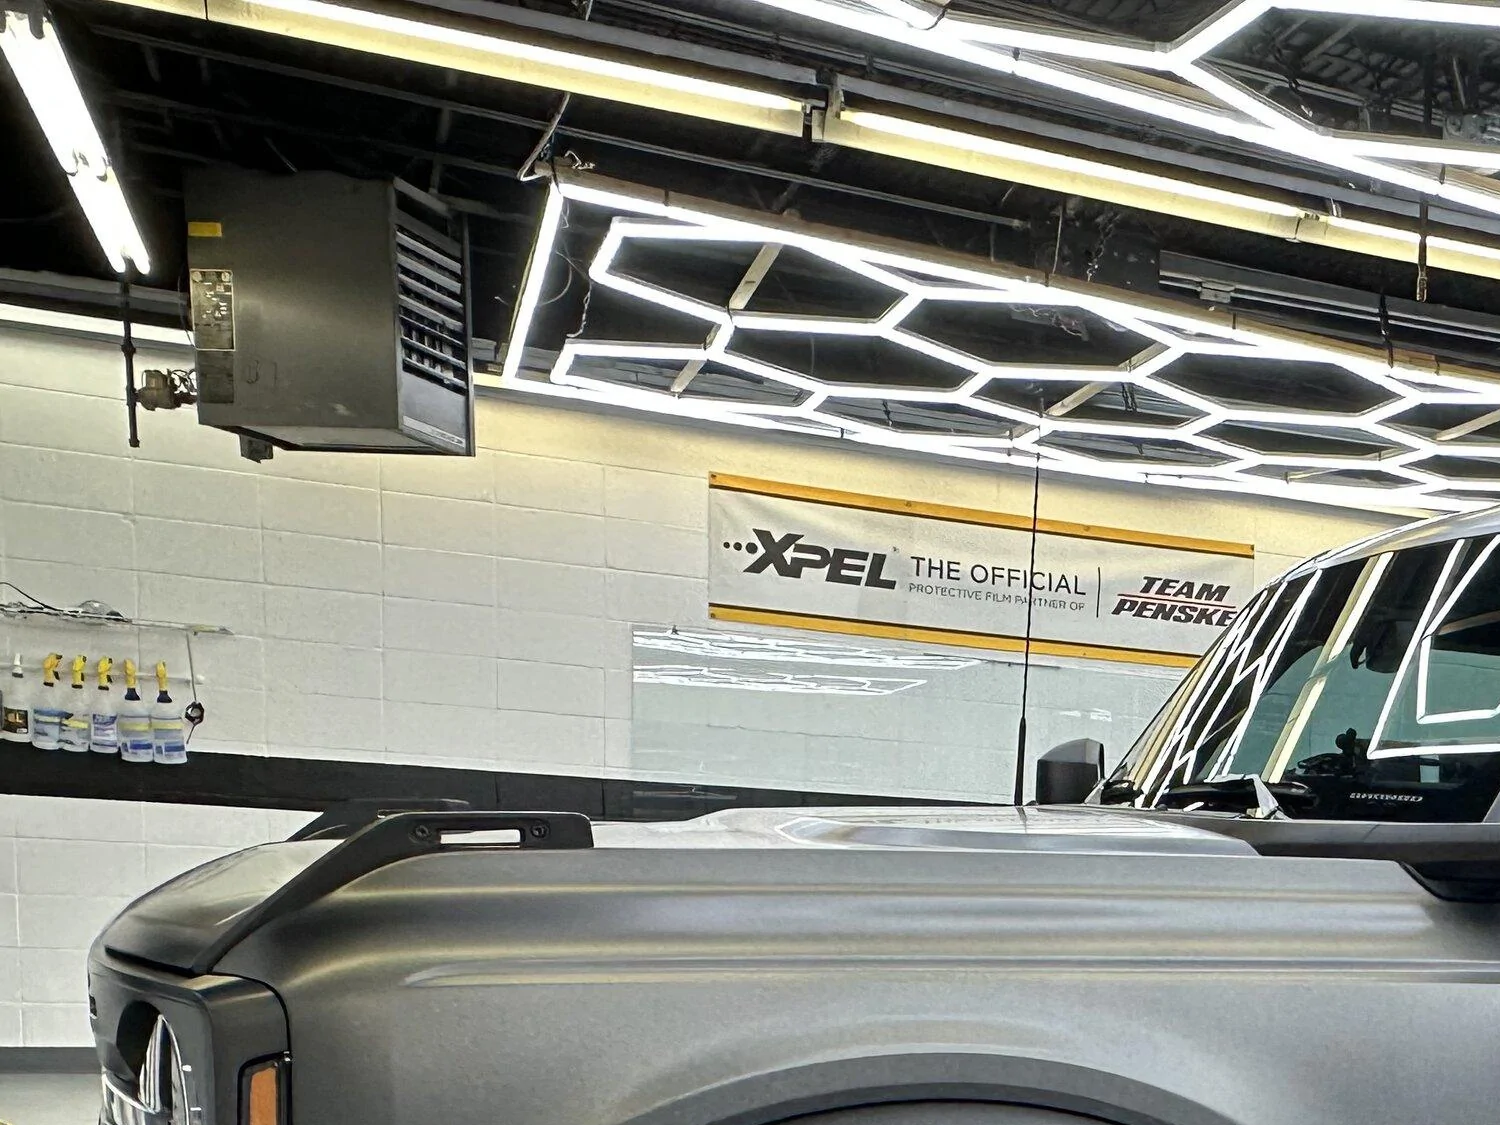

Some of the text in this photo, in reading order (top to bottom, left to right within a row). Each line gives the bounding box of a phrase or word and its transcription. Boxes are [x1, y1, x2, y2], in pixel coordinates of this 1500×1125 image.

[743, 528, 897, 590] XPEL
[910, 556, 1087, 596] THE OFFICIAL
[1139, 576, 1230, 602] TEAM
[909, 582, 982, 601] PROTECTIVE
[985, 591, 1012, 604] FILM
[1069, 601, 1085, 611] OF
[1111, 598, 1237, 627] PENSKE
